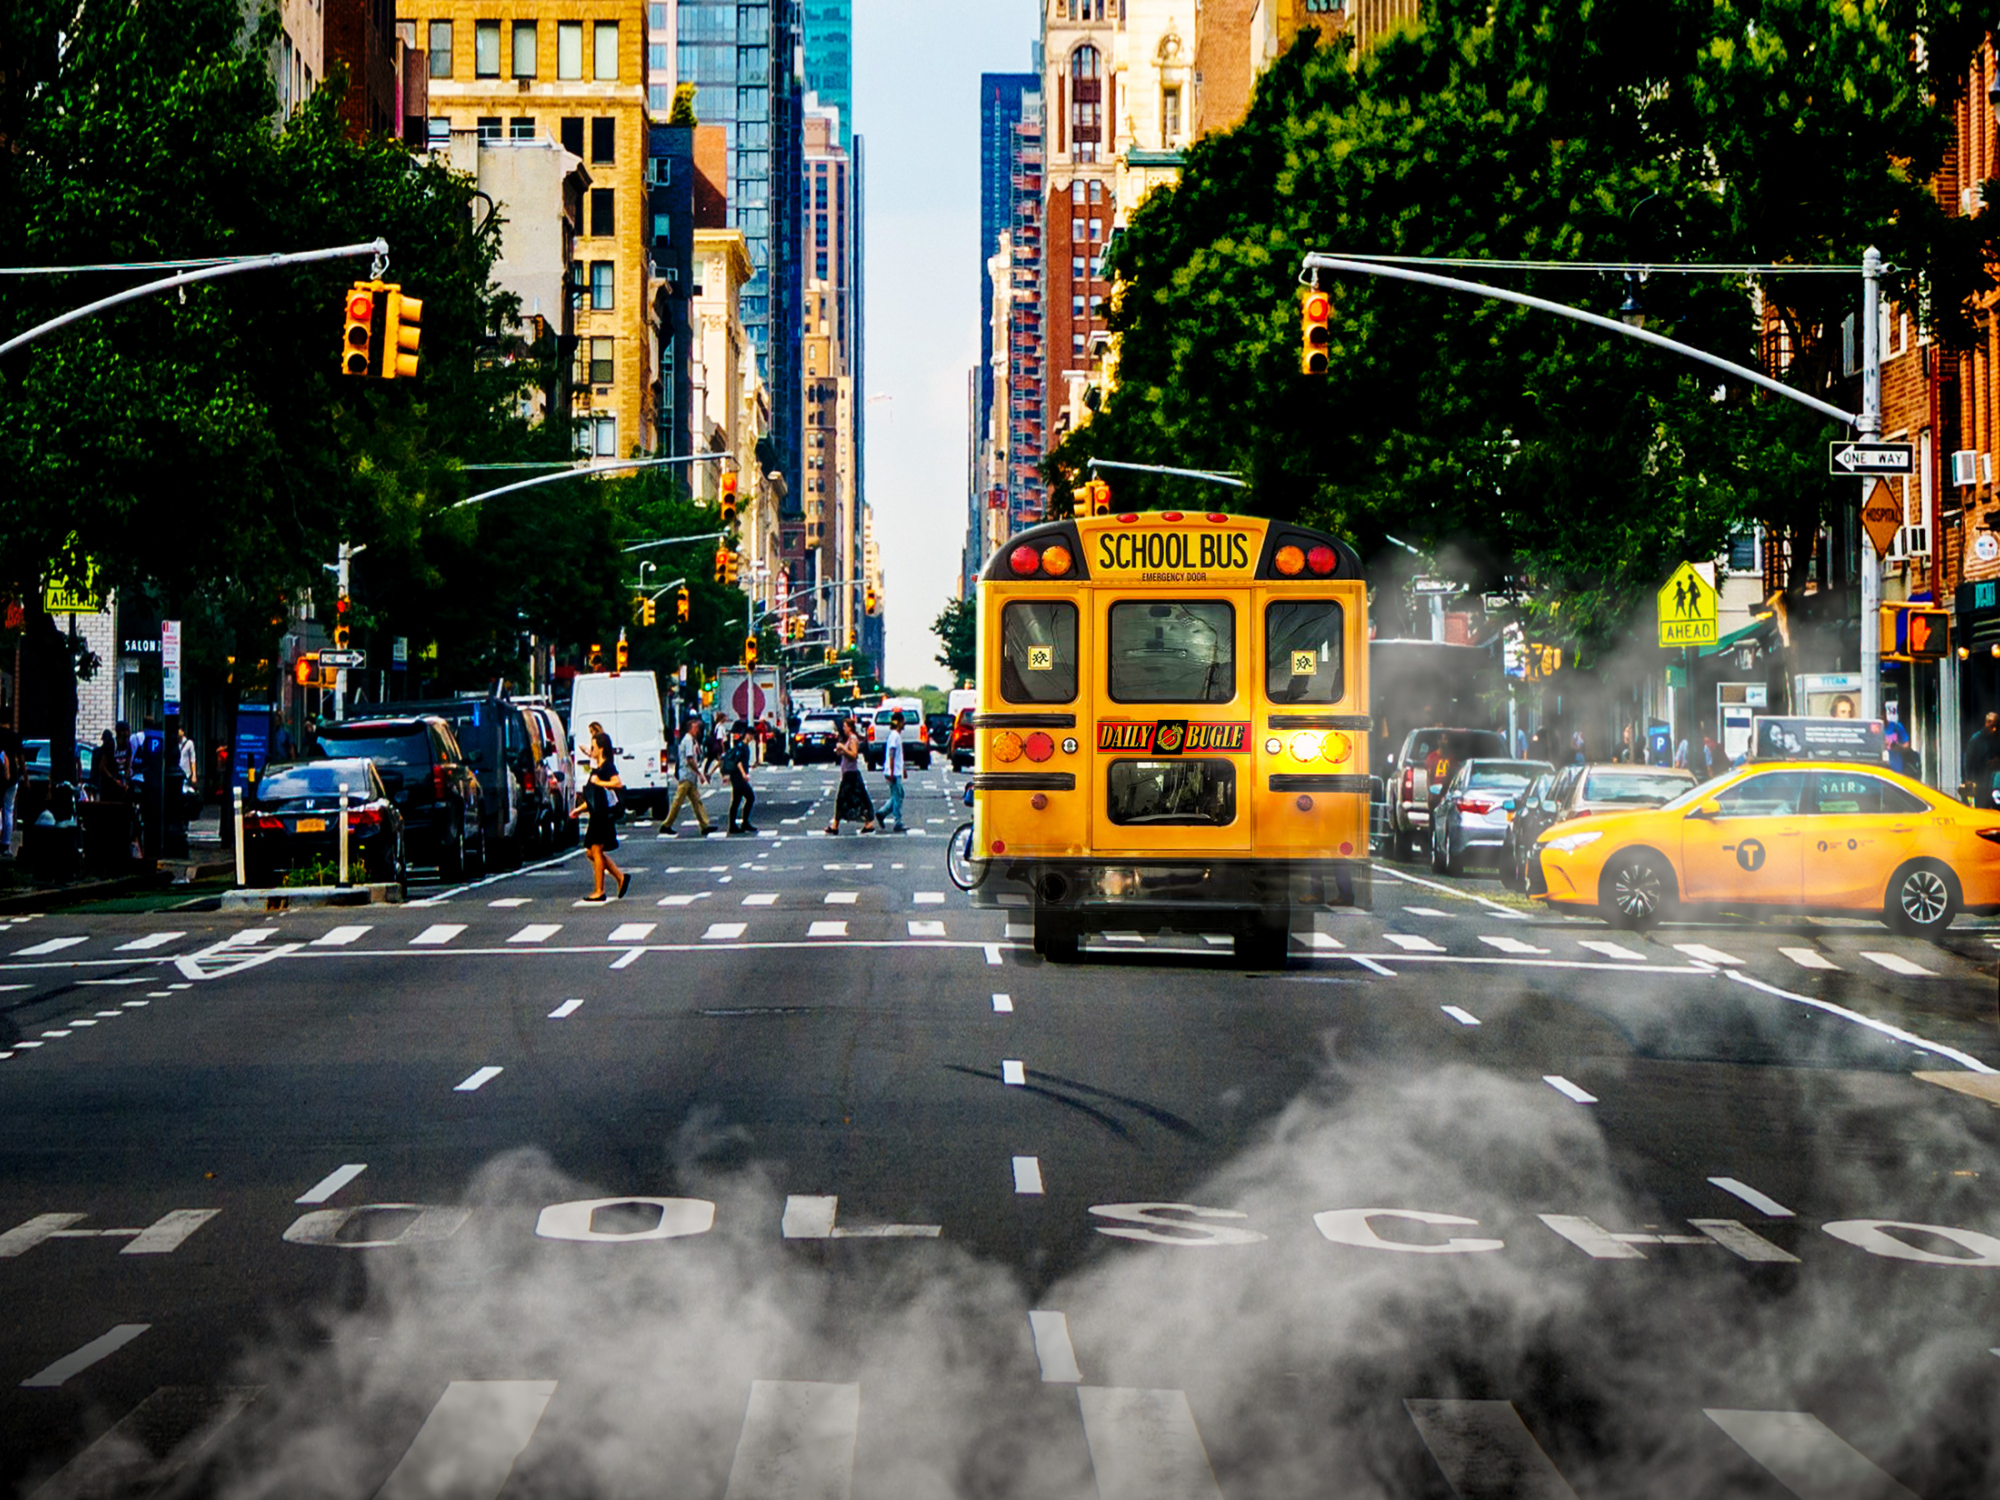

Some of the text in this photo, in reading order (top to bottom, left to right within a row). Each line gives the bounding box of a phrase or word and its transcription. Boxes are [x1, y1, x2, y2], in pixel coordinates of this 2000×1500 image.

[1843, 452, 1903, 464] ONE WAY
[1866, 508, 1899, 523] HOSPITAL
[1099, 532, 1249, 570] SCHOOL BUS
[1141, 572, 1207, 582] EMERGENCY DOOR
[1666, 623, 1711, 640] AHEAD
[125, 640, 156, 652] SALON
[1098, 725, 1245, 749] DAILY BUGLE
[151, 739, 160, 752] P
